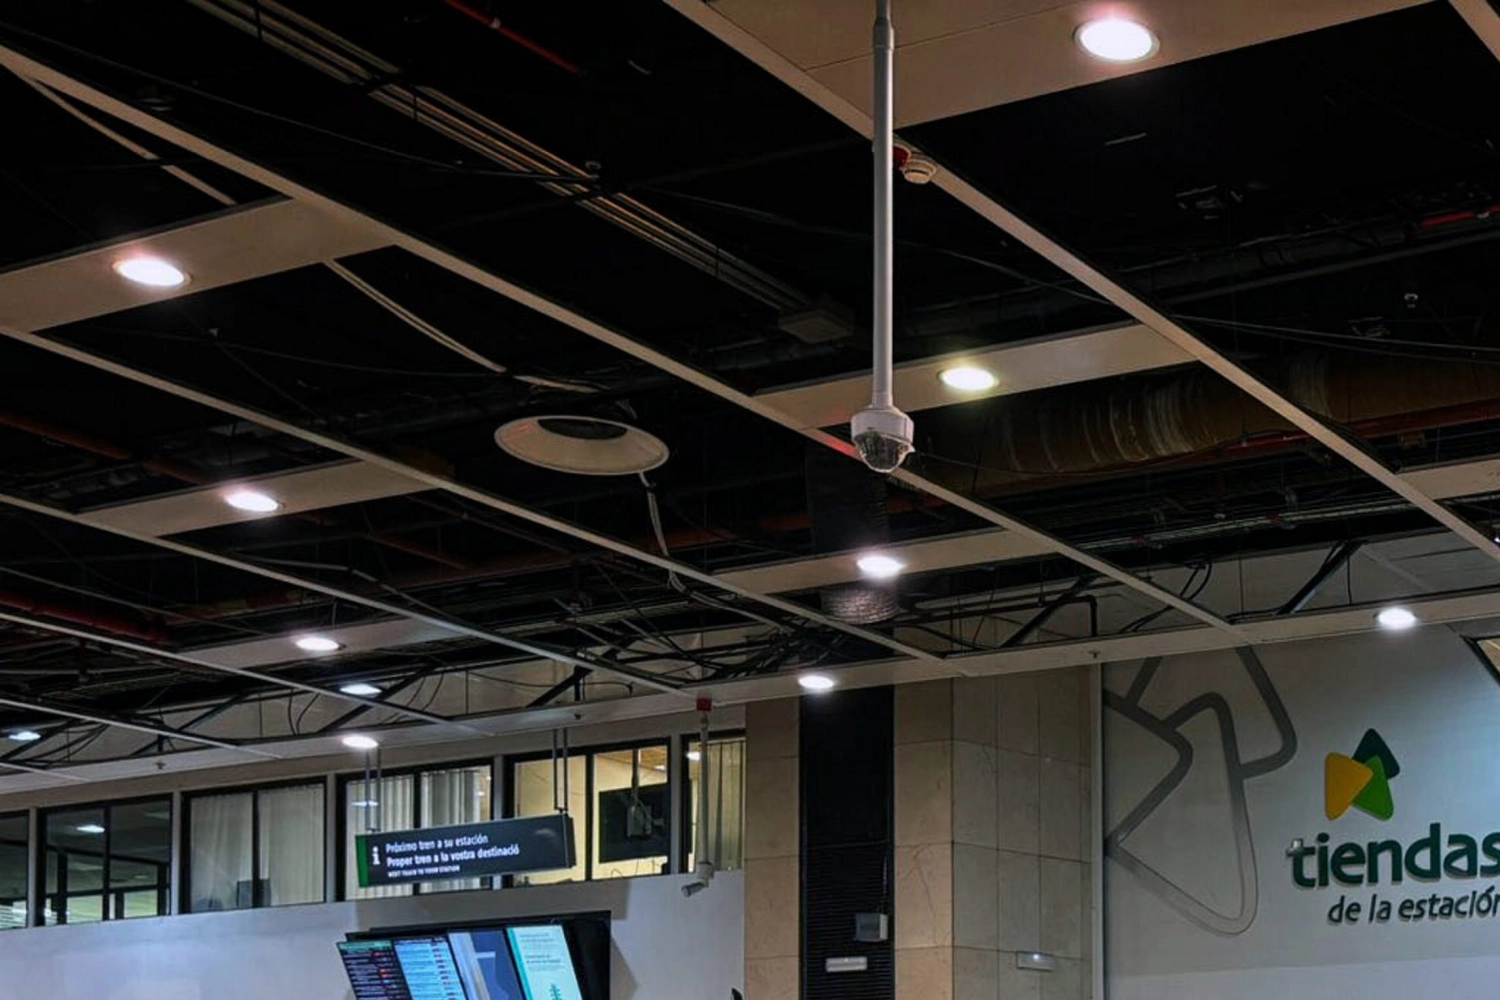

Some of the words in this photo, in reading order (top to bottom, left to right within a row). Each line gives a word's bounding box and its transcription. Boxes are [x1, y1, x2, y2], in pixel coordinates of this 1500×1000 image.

[385, 841, 417, 853] Próximo
[419, 840, 435, 850] tren
[437, 840, 442, 848] a
[444, 837, 454, 847] su
[455, 833, 489, 846] estación
[386, 856, 413, 867] Proper
[415, 854, 432, 864] tren
[440, 851, 449, 862] la
[451, 849, 475, 861] vostra
[477, 843, 520, 858] destinació
[1328, 895, 1361, 923] de
[1368, 893, 1392, 924] la
